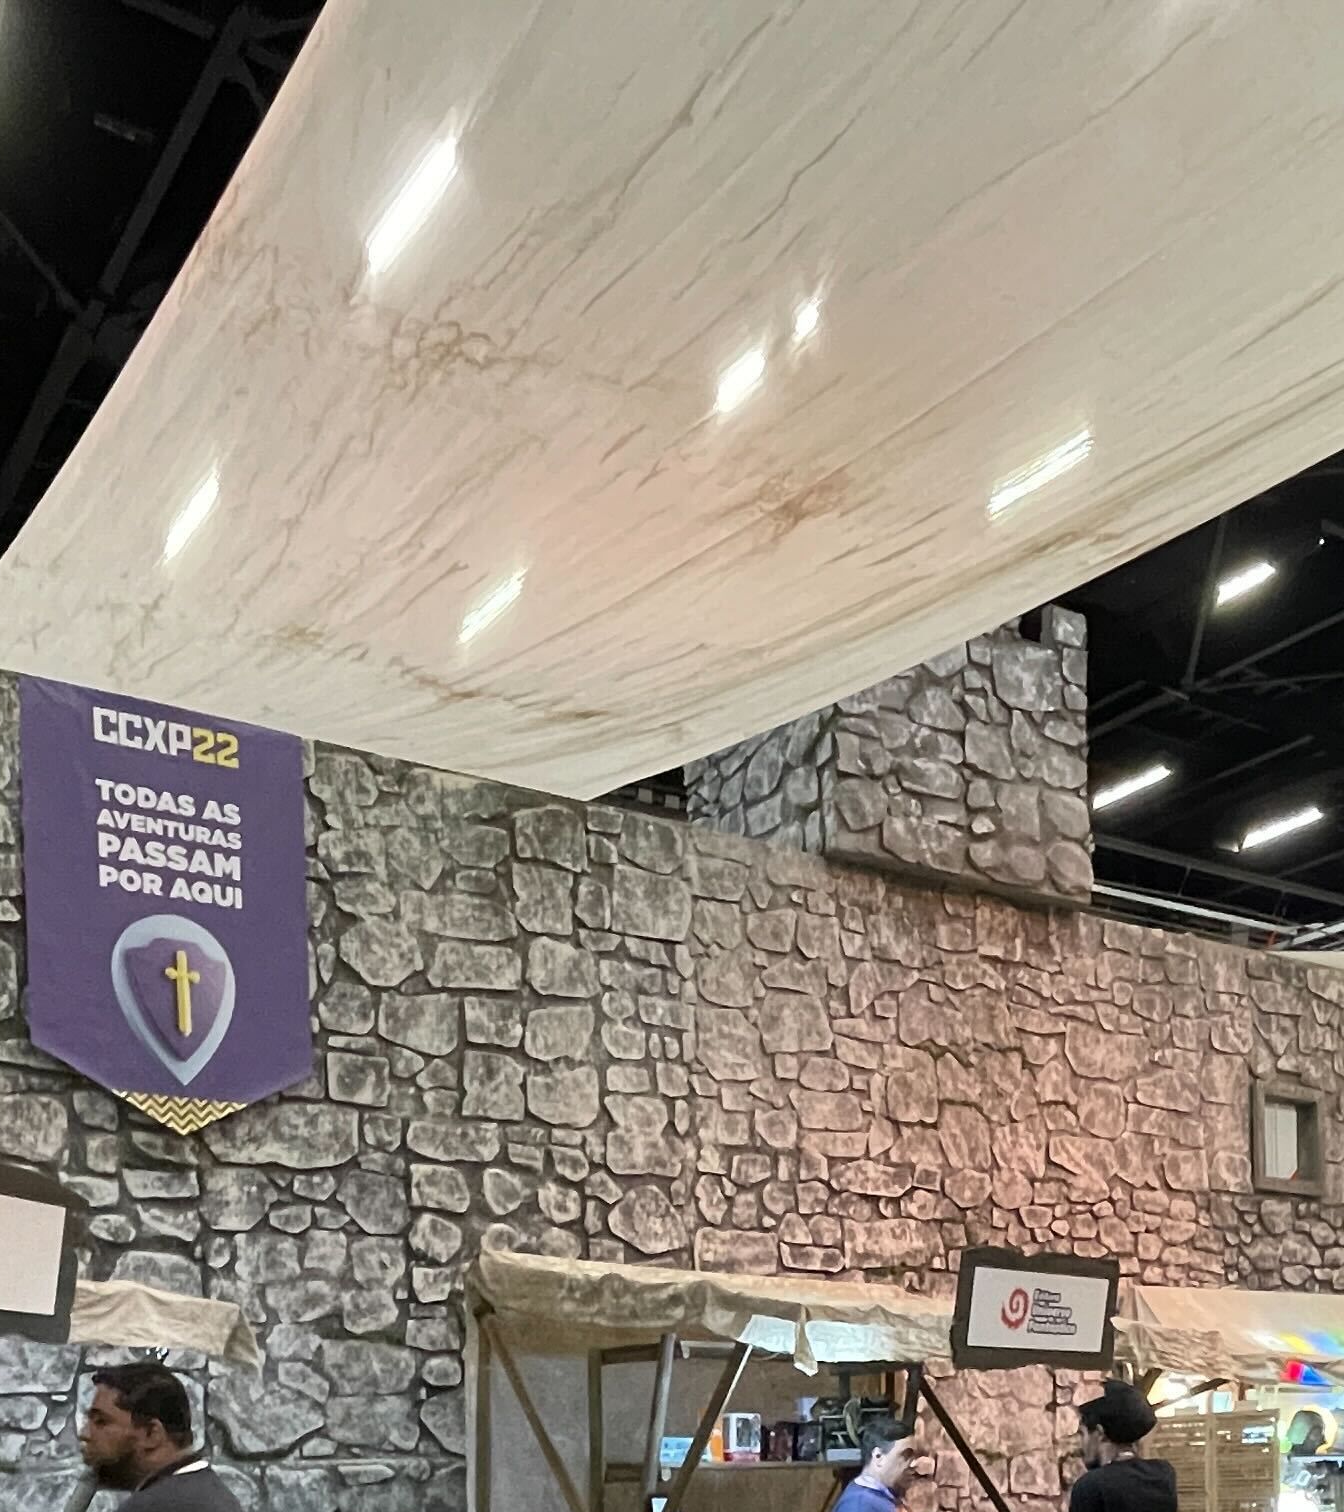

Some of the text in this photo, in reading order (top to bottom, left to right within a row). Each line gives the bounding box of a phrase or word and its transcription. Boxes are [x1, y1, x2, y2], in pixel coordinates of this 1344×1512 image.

[92, 706, 240, 769] CCXP22
[95, 777, 241, 826] TODAS AS
[95, 808, 242, 850] AVENTURAS
[97, 831, 241, 882] PASSAM
[98, 864, 243, 909] POR AQUI
